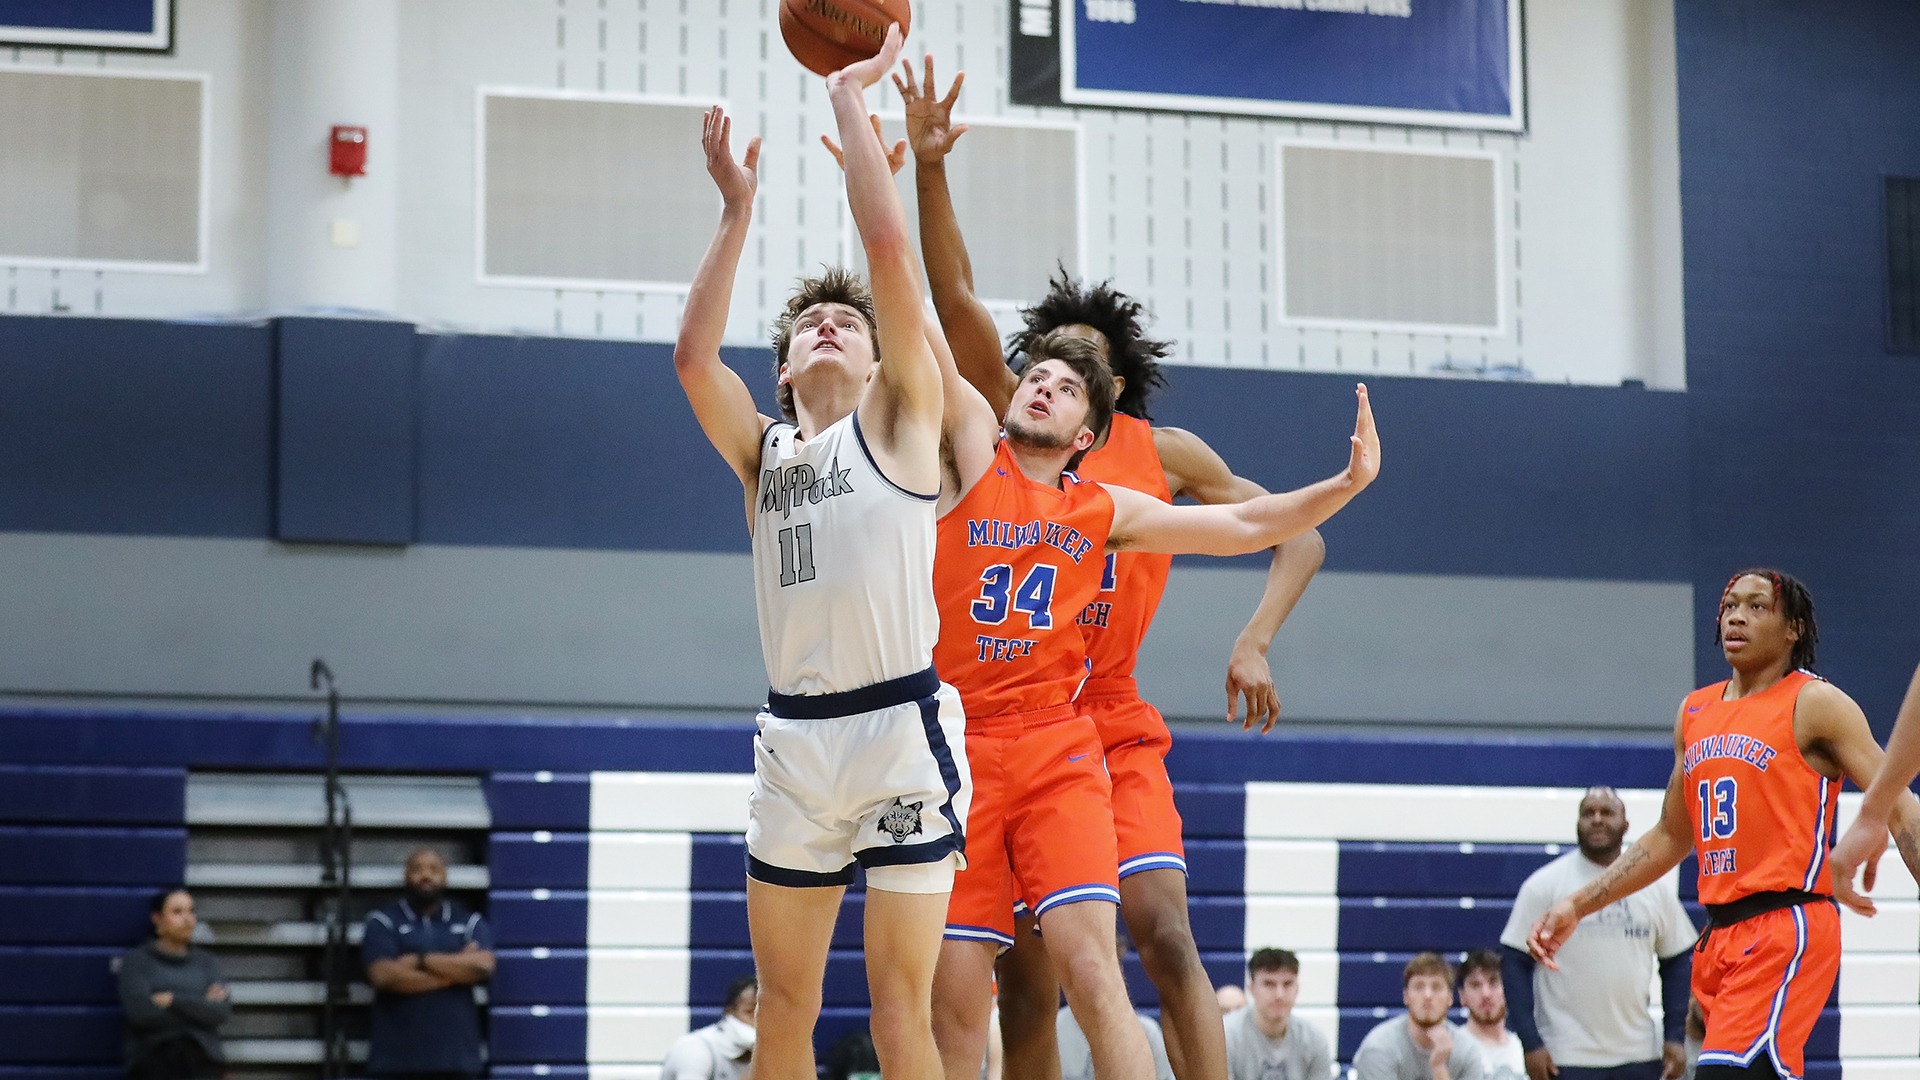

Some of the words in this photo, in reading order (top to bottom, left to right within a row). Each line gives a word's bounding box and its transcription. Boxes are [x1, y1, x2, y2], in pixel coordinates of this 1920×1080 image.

[778, 522, 816, 588] 11
[967, 518, 1094, 566] MILWAKEE
[969, 563, 1058, 630] 34
[1076, 602, 1113, 629] CH
[1698, 775, 1739, 842] 13
